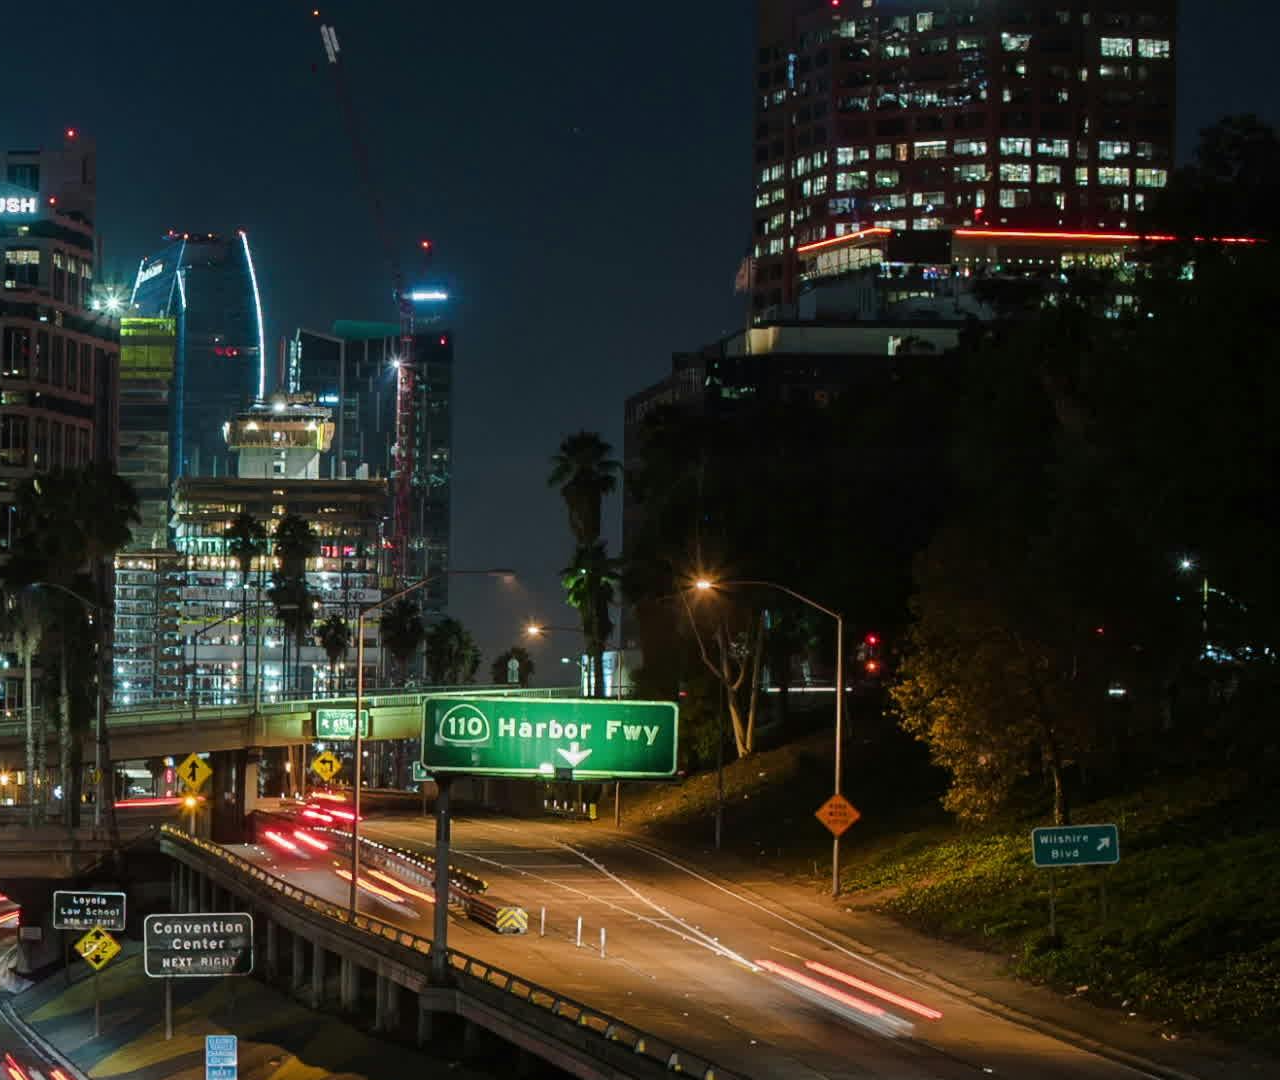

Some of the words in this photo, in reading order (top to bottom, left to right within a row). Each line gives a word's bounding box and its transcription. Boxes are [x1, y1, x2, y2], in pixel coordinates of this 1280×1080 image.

[448, 717, 483, 736] 110
[498, 718, 592, 739] Harbor
[606, 720, 659, 745] Fwy
[1040, 835, 1089, 844] Wilshire
[1051, 849, 1080, 858] Blvd
[73, 896, 107, 906] Loyola
[60, 907, 81, 915] Law
[85, 908, 120, 916] School
[153, 921, 244, 934] Convention
[172, 938, 225, 950] Center
[162, 958, 193, 968] NEXT
[200, 957, 238, 966] RIGHT
